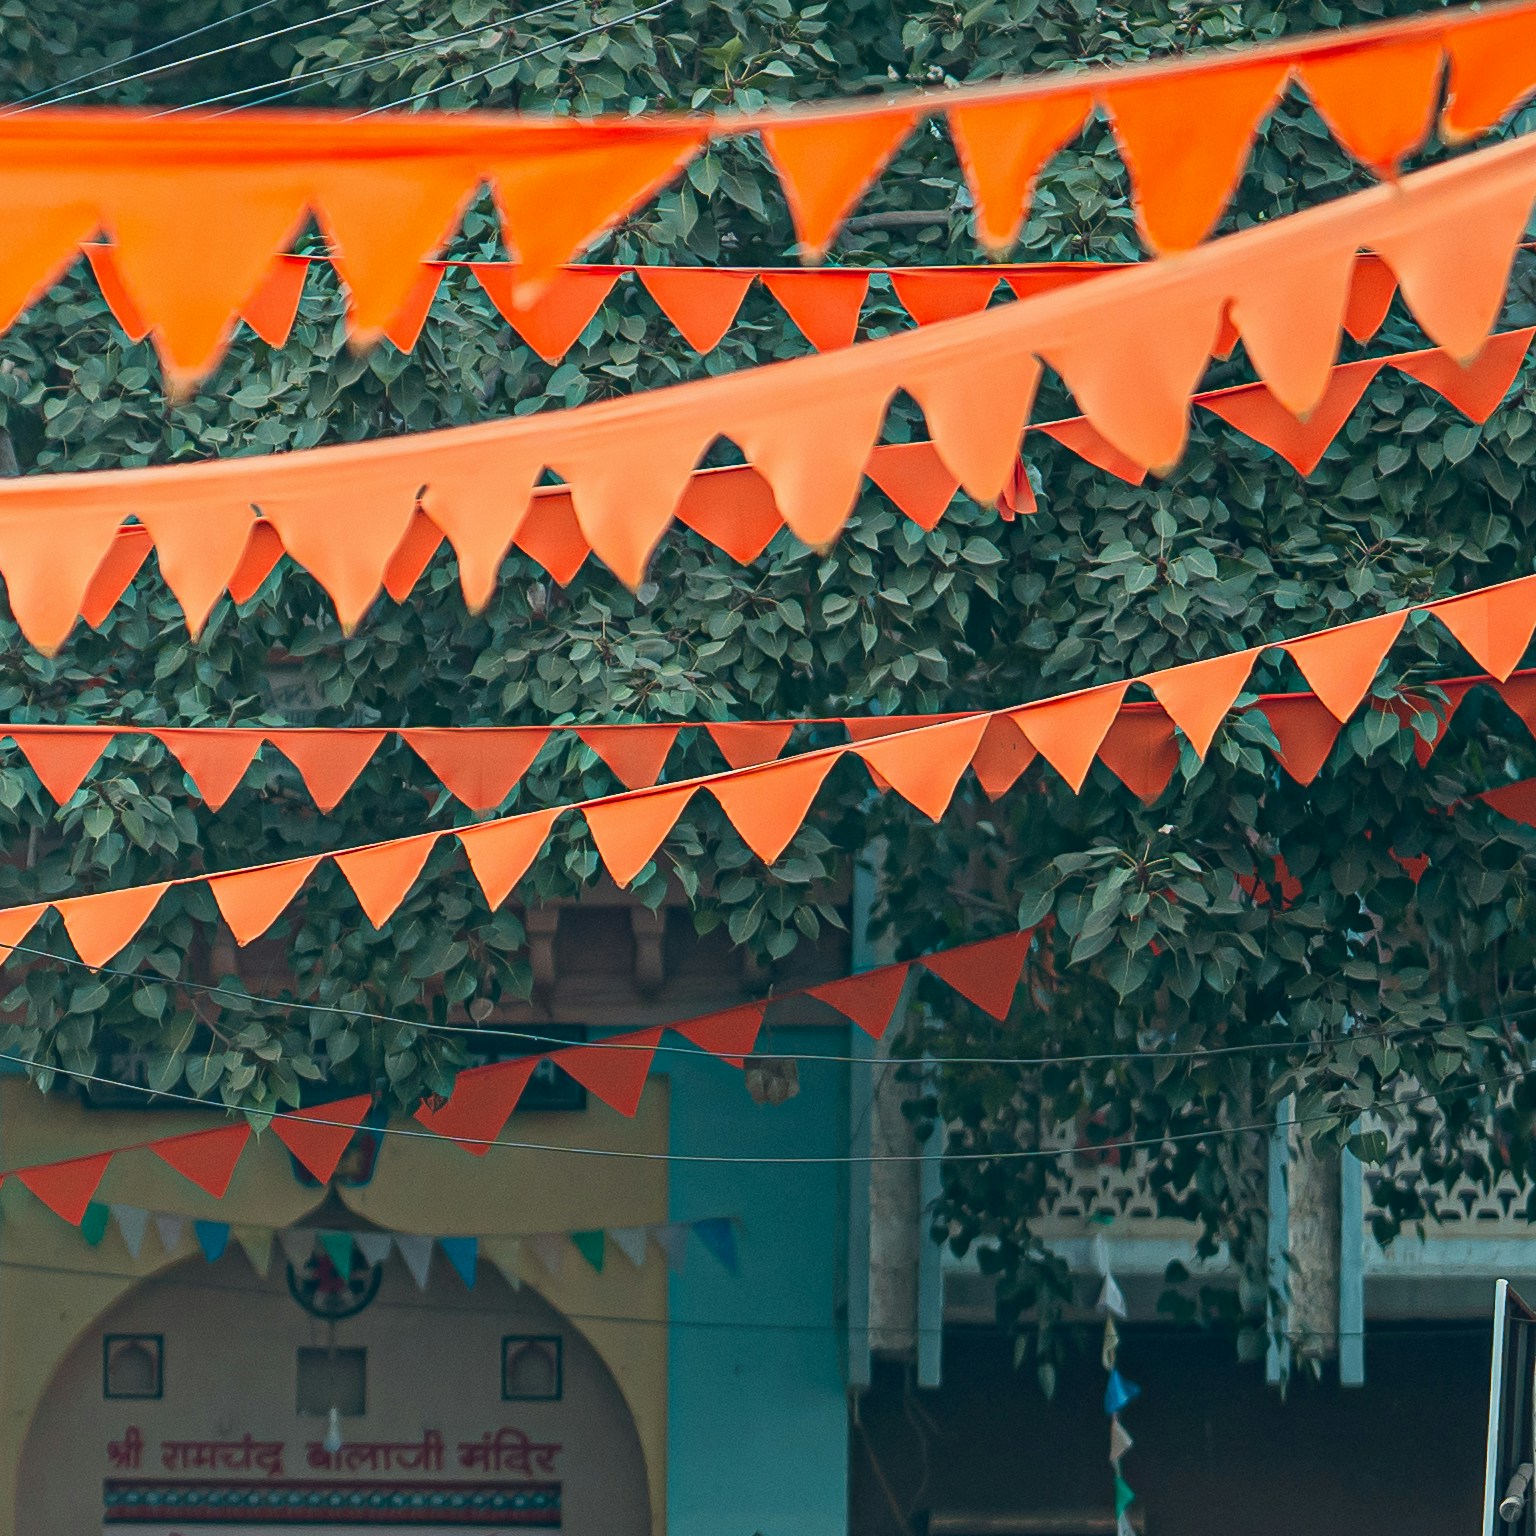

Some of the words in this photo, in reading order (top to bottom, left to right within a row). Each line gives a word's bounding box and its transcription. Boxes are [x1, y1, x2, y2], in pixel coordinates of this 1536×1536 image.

[107, 1426, 143, 1470] श्री
[161, 1433, 285, 1476] रामचंद्र
[306, 1429, 446, 1471] बालाजी
[458, 1428, 562, 1476] मंदिर
